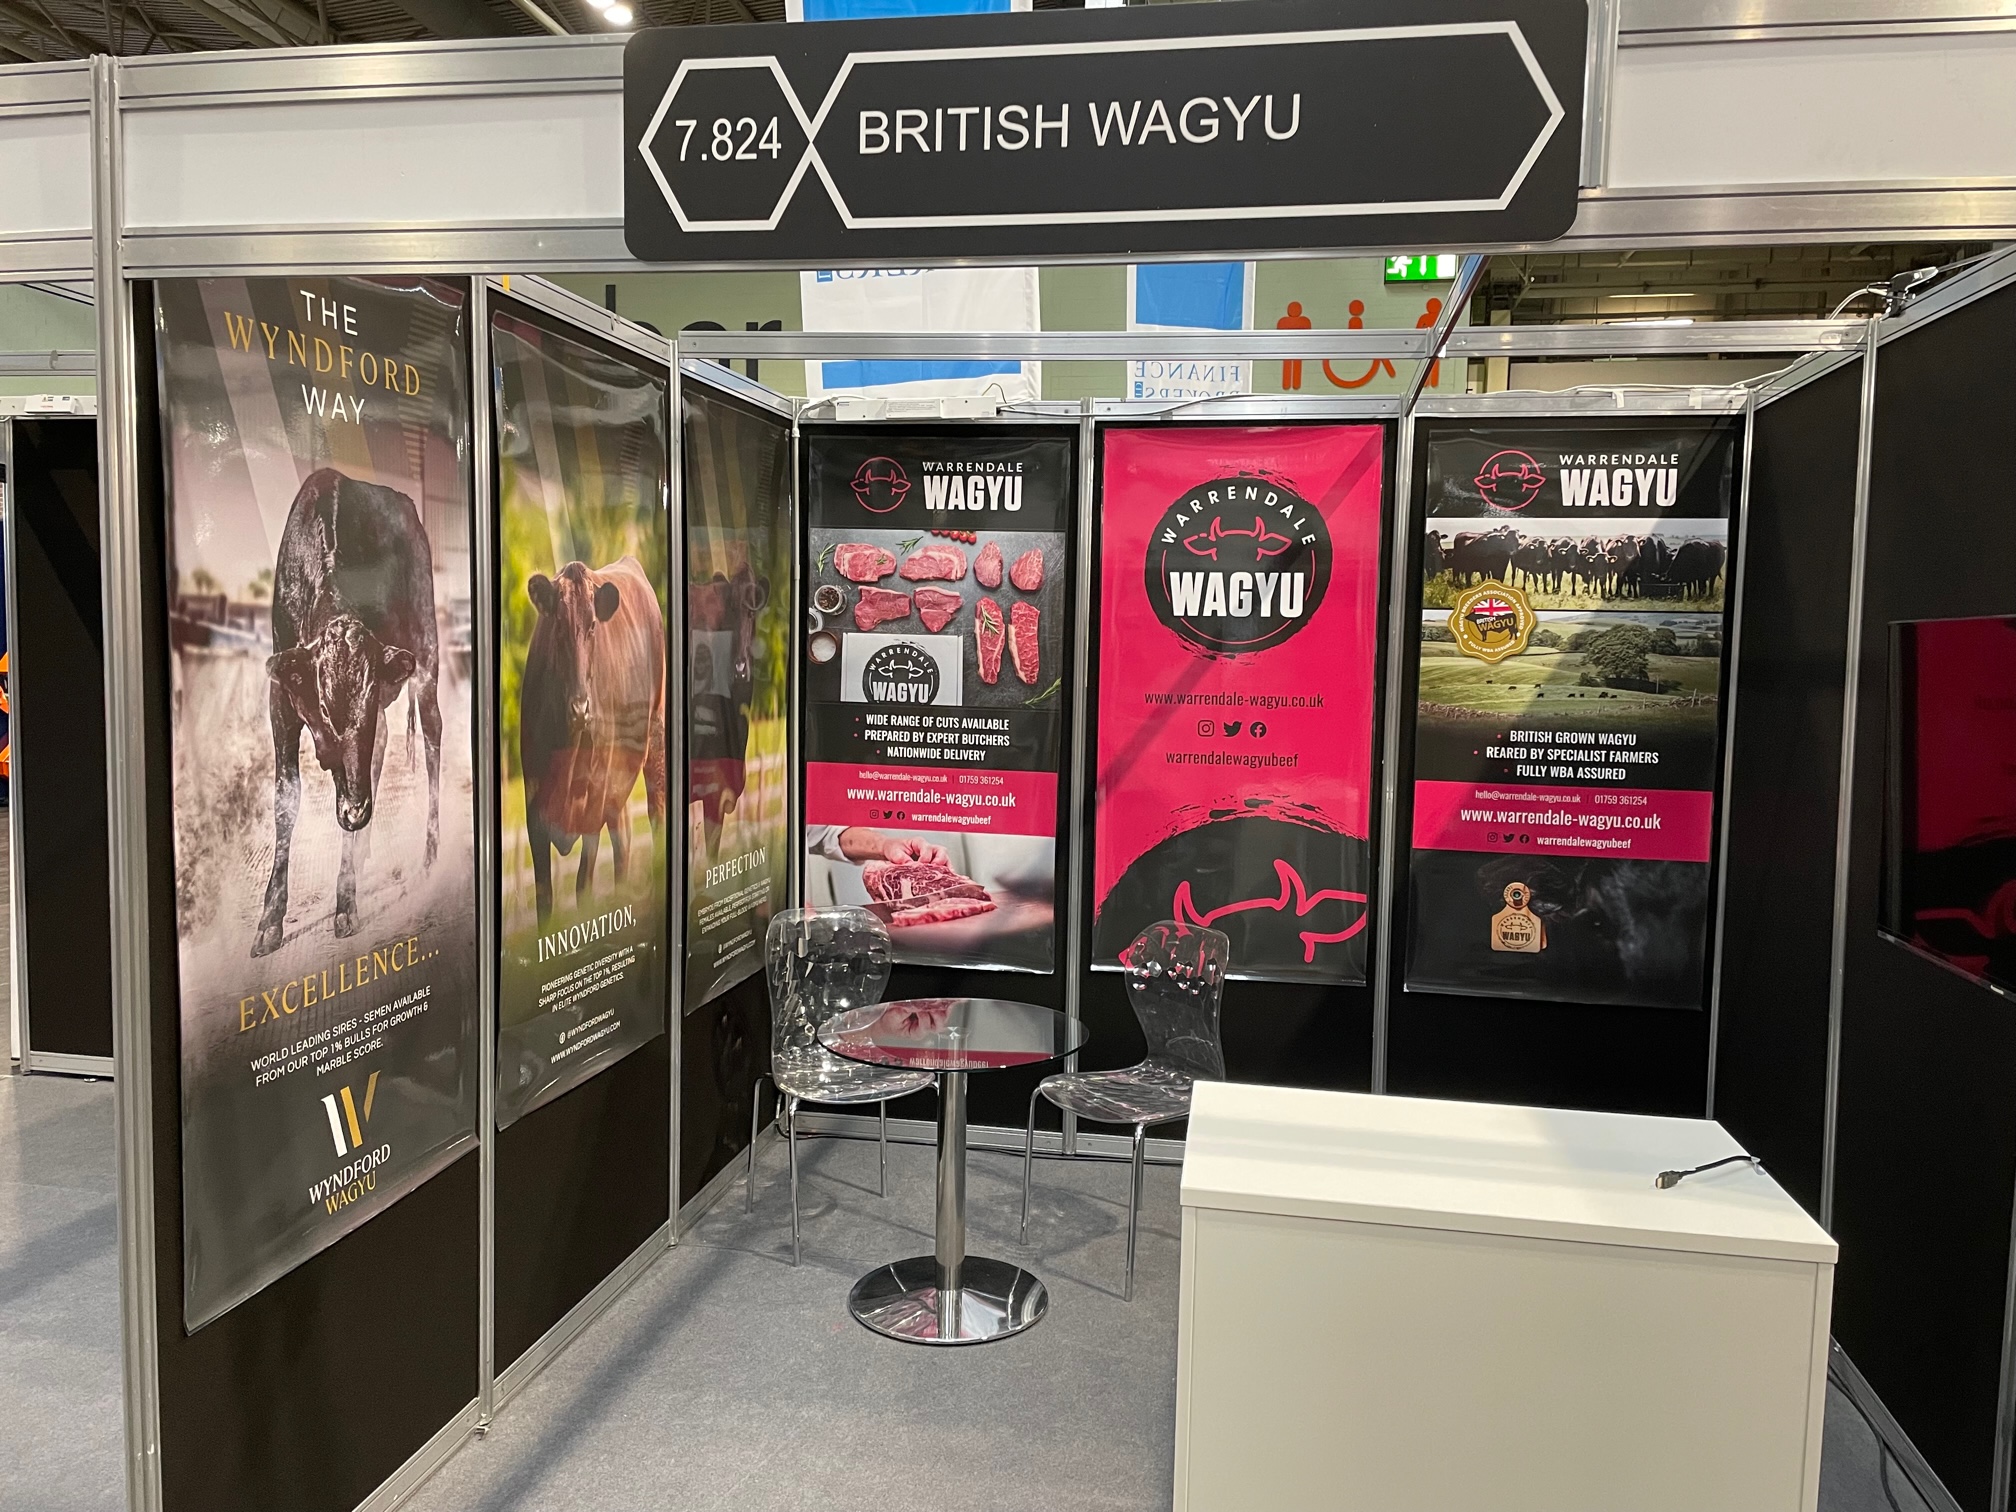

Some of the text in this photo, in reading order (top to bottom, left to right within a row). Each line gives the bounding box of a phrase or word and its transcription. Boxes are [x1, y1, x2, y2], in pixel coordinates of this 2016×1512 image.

[858, 93, 1302, 154] BRITISH WAGYU
[675, 117, 782, 161] 7.824
[300, 290, 358, 336] THE
[224, 312, 420, 396] WYNDFORD
[301, 384, 365, 425] WAY
[923, 462, 1023, 472] WARRENDALE
[1559, 454, 1679, 465] WARRENDALE
[923, 475, 1022, 512] WAGYU
[1560, 468, 1678, 507] WAGYU
[1161, 486, 1316, 545] WARRENDALE
[1169, 571, 1305, 618] WAGYU
[1483, 590, 1516, 604] ASSOCIATION
[1476, 616, 1496, 625] BRITISH
[1478, 618, 1514, 631] WAGYU
[869, 648, 933, 674] WARRENDALE
[872, 681, 929, 703] WAGYU
[1144, 692, 1324, 709] www.warrendale-wagyu.co.uk
[866, 714, 1009, 730] WIDE RANGE OF CUTS AVAILABLE
[865, 730, 1010, 746] PREPARED BY EXPERT BUTCHERS
[1510, 730, 1637, 746] BRITISH GROWN WAGYU
[887, 747, 986, 761] NATIONWIDE DELIVERY
[1166, 751, 1299, 768] warrendalewagyubeef
[1486, 746, 1659, 764] REARED BY SPECIALIST FARMERS
[858, 770, 1004, 785] hello@warrendale-wagyu.co.uk 01759 361254
[1516, 764, 1626, 780] FULLY WBA ASSURED
[847, 788, 1016, 807] www.warrendale-wagyu.co.uk
[1475, 790, 1648, 806] hello@warrendale-wagyu.co.uk 01759 361254
[911, 812, 992, 825] warrendalewagyubeef
[1460, 808, 1661, 829] www.warrendale-wagyu.co.uk
[1537, 835, 1632, 849] warrendalewagyubeef
[706, 847, 766, 889] PERFECTION
[538, 904, 637, 963] INNOVATION,
[239, 936, 440, 1032] EXCELLENCE...
[538, 992, 557, 1008] SHARP
[557, 983, 575, 999] FOCUS
[574, 980, 583, 990] ON
[583, 974, 593, 985] THE
[593, 970, 603, 980] TOP
[611, 955, 636, 972] RESULTING
[541, 972, 573, 994] PIONEERING
[573, 962, 594, 979] GENETIC
[594, 953, 618, 970] DIVERSITY
[558, 996, 572, 1009] ELITE
[572, 982, 600, 1002] WYNDFORD
[250, 1047, 289, 1072] WORLD
[291, 1029, 331, 1056] LEADING
[332, 1018, 358, 1038] SIRES
[363, 1003, 392, 1024] SEMEN
[392, 985, 431, 1010] AVAILABLE
[255, 1065, 286, 1087] FROM
[287, 1055, 308, 1073] OUR
[310, 1046, 329, 1064] TOP
[331, 1039, 343, 1054] 1%
[344, 1027, 371, 1048] BULLS
[372, 1019, 389, 1035] FOR
[390, 1005, 422, 1026] GROWTH
[316, 1037, 384, 1077] MARBLE SCORE.
[308, 1143, 391, 1205] WYNDFORD
[325, 1170, 377, 1216] WAGYU
